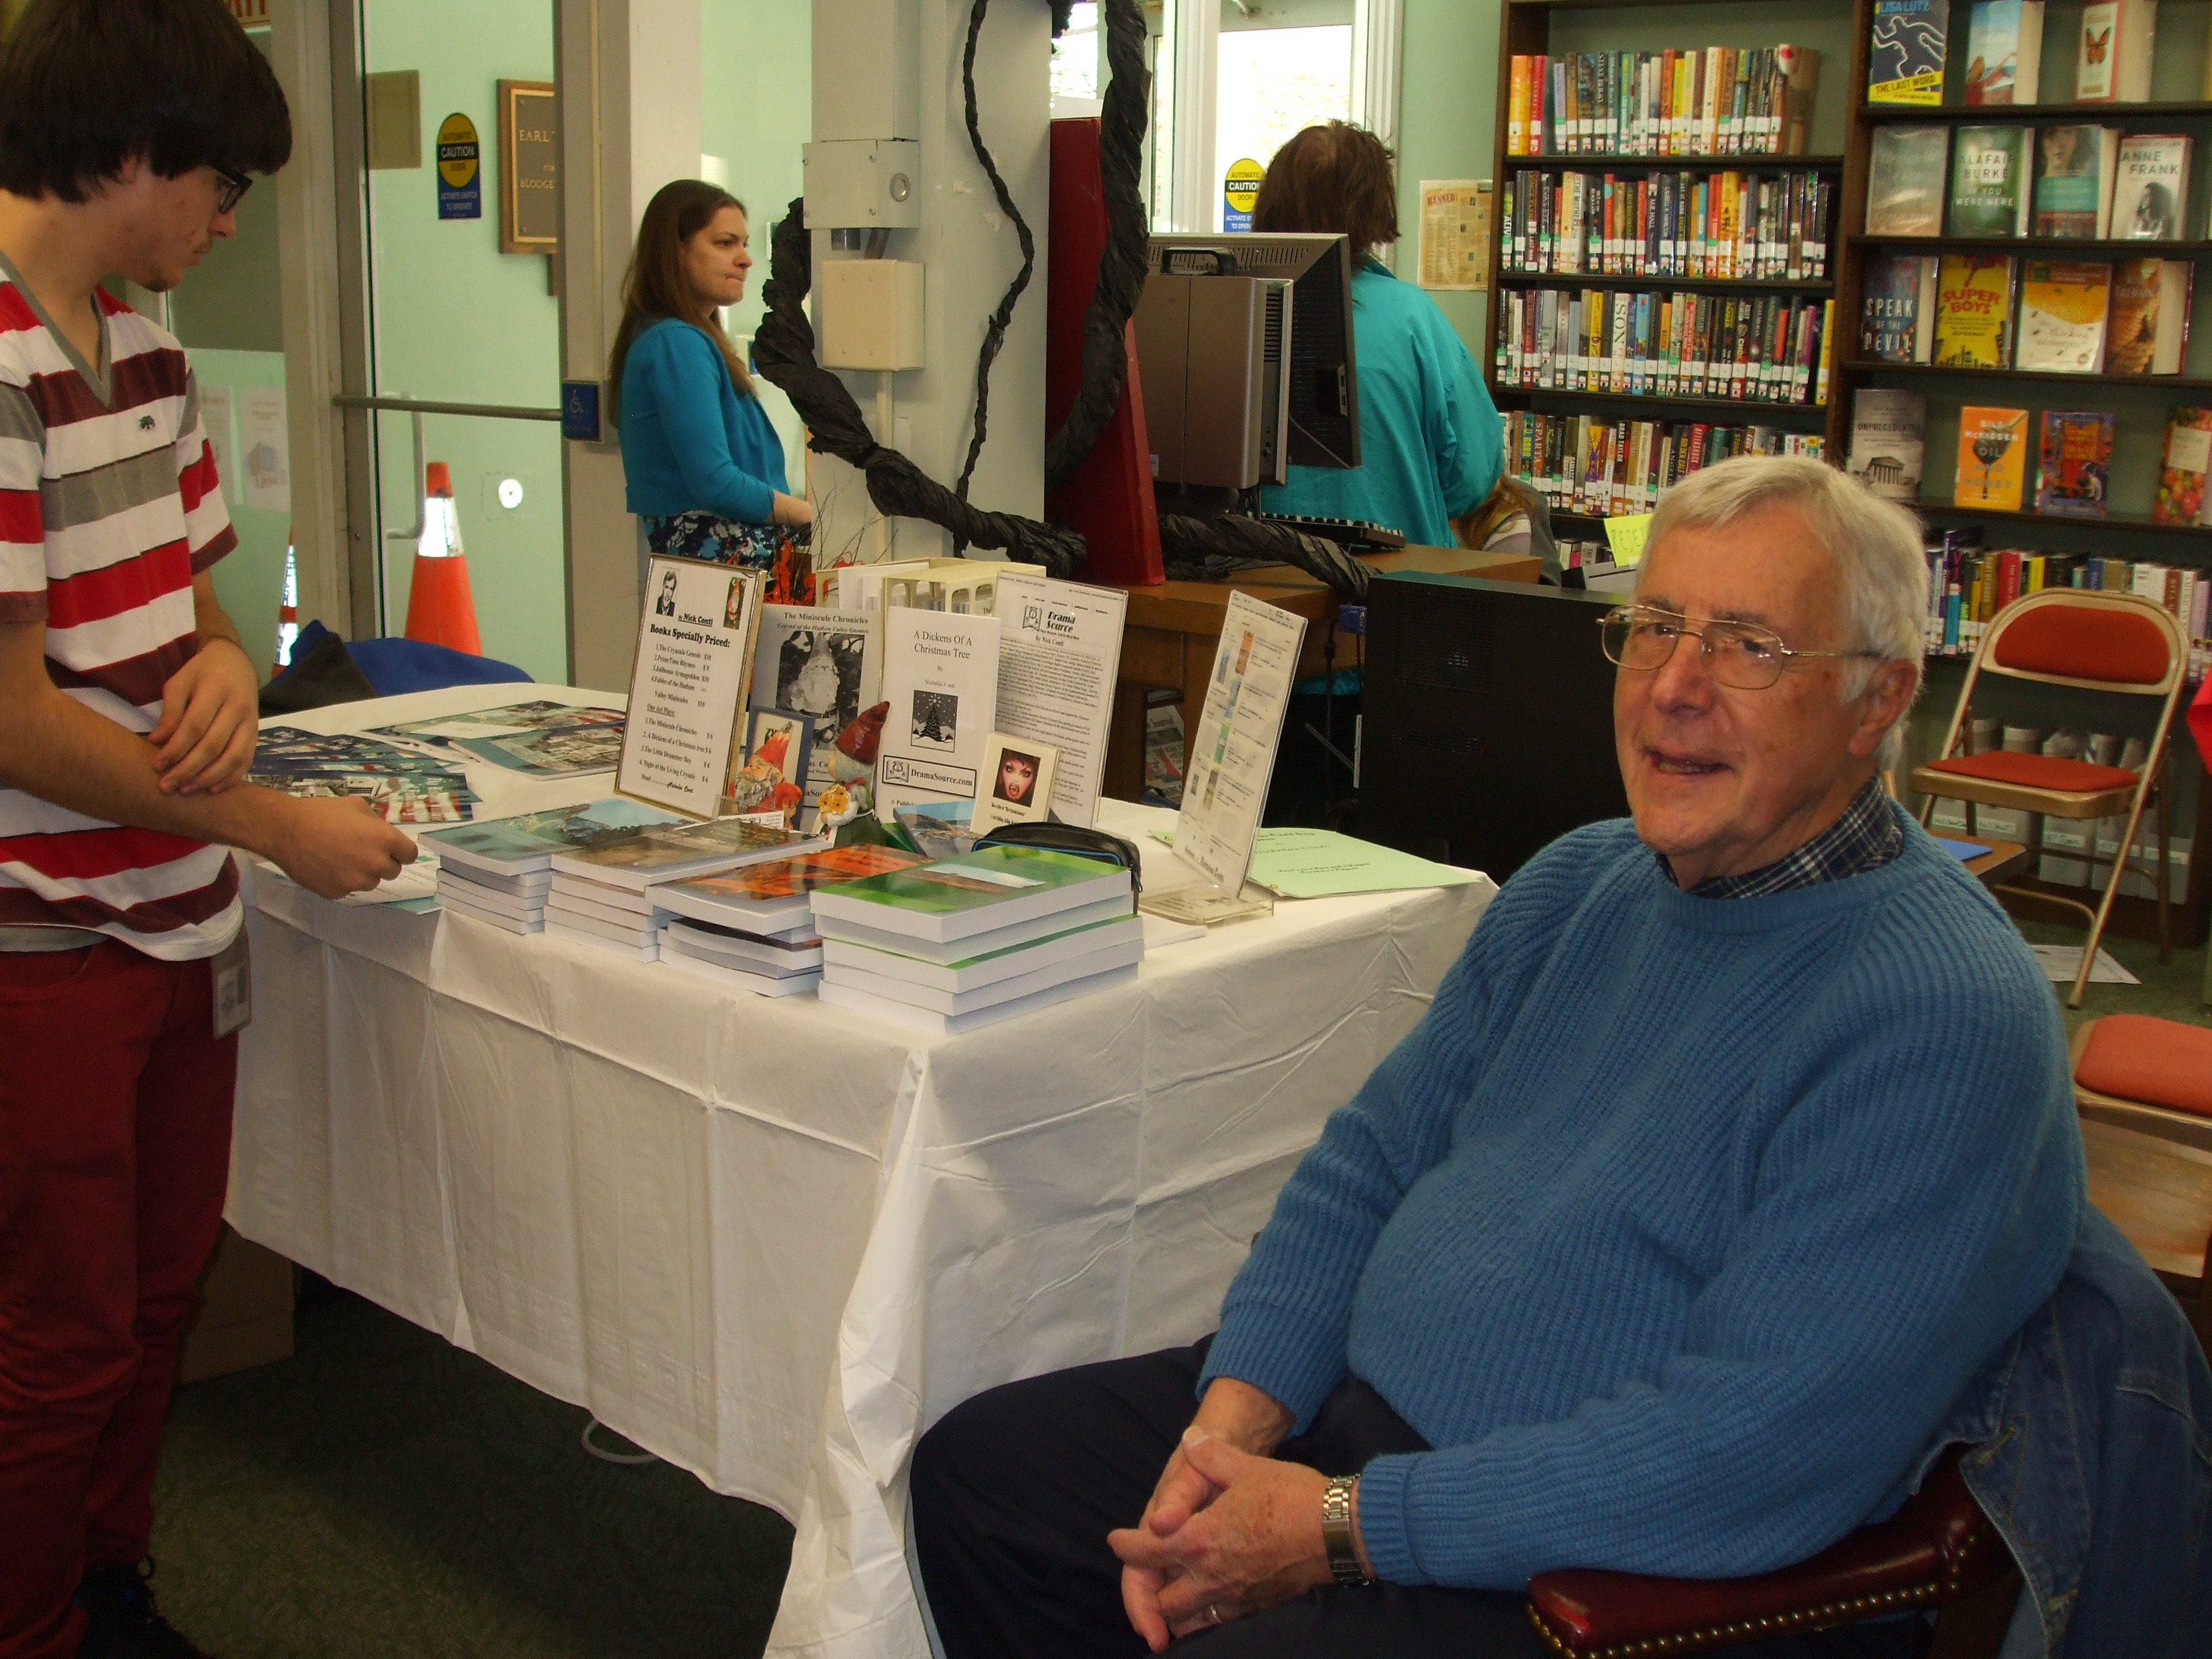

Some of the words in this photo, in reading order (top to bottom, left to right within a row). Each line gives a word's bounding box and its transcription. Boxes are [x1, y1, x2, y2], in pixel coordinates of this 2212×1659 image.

[440, 146, 474, 158] CAUTION
[2121, 150, 2162, 162] ANNE
[1965, 168, 2009, 179] BURKE
[2129, 164, 2180, 175] FRANK
[519, 180, 556, 189] BLODGE
[1573, 181, 1581, 195] THE
[1572, 196, 1580, 228] MOTHERS
[1942, 289, 2001, 305] SUPER
[1865, 297, 1913, 318] SPEAK
[1950, 301, 1991, 315] BOYS
[1613, 303, 1627, 344] SON
[1889, 321, 1901, 330] THE
[1864, 332, 1911, 352] DEVIL
[1617, 423, 1626, 439] BRAD
[1534, 422, 1544, 463] SPARTA
[1616, 440, 1625, 462] TAYLOR
[1979, 447, 2001, 458] OIL
[685, 613, 697, 622] Nick
[698, 616, 713, 625] Conti
[799, 612, 832, 622] Miniscule
[832, 615, 869, 624] Chronicles
[1047, 611, 1076, 624] Drama
[1046, 619, 1074, 633] Source
[650, 623, 671, 636] Books
[672, 628, 704, 644] Specially
[705, 634, 731, 648] Priced:
[913, 630, 920, 639] A
[922, 631, 952, 643] Dickens
[953, 635, 965, 645] Of
[966, 637, 972, 646] A
[1042, 636, 1052, 644] Nick
[1052, 638, 1064, 646] Conti
[914, 643, 952, 656] Christmas
[953, 648, 970, 659] Tree
[676, 725, 697, 736] Chronicles
[676, 739, 696, 750] Christmas
[653, 748, 664, 756] Little
[664, 750, 684, 762] Drummer
[644, 760, 654, 769] Night
[666, 766, 679, 777] Living
[911, 768, 973, 787] DramaSource.com
